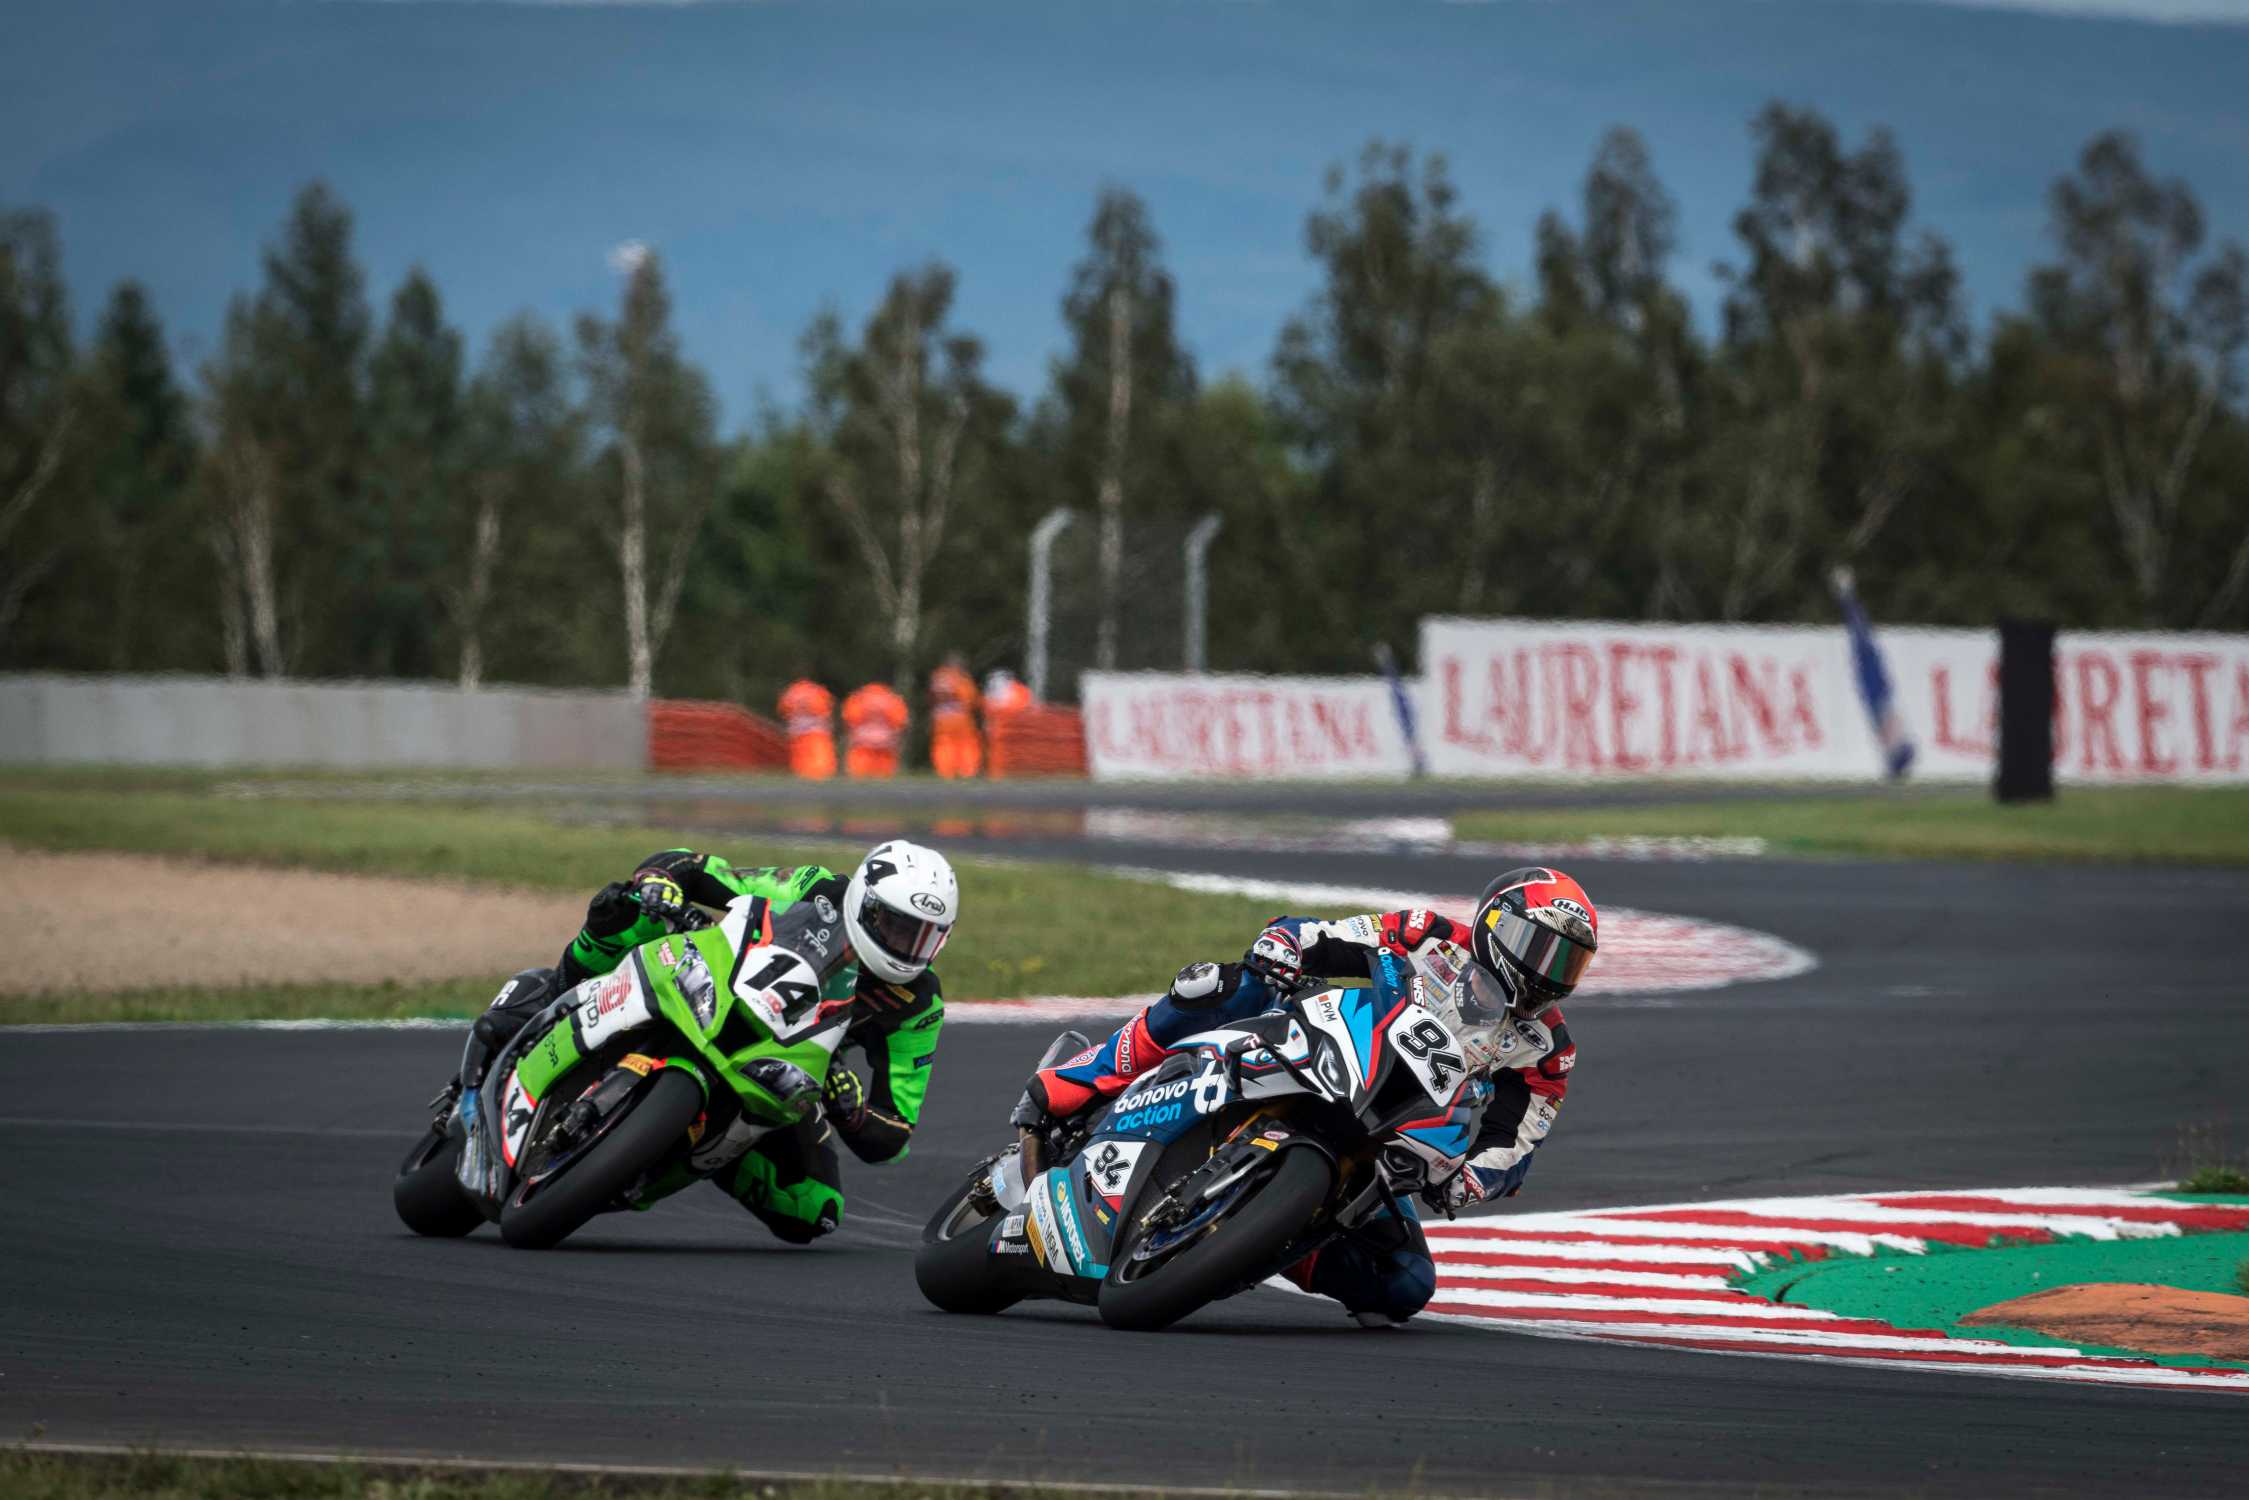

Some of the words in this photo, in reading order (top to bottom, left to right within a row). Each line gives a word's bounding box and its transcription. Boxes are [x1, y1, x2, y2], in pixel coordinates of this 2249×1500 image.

[1442, 640, 1824, 772] LAURETANA
[1554, 900, 1590, 920] HJC
[743, 952, 819, 1027] 14
[1396, 1019, 1466, 1094] 94
[506, 1087, 532, 1139] 14
[1114, 1080, 1189, 1113] bonovo
[1115, 1102, 1183, 1132] action
[1093, 1141, 1132, 1190] 94
